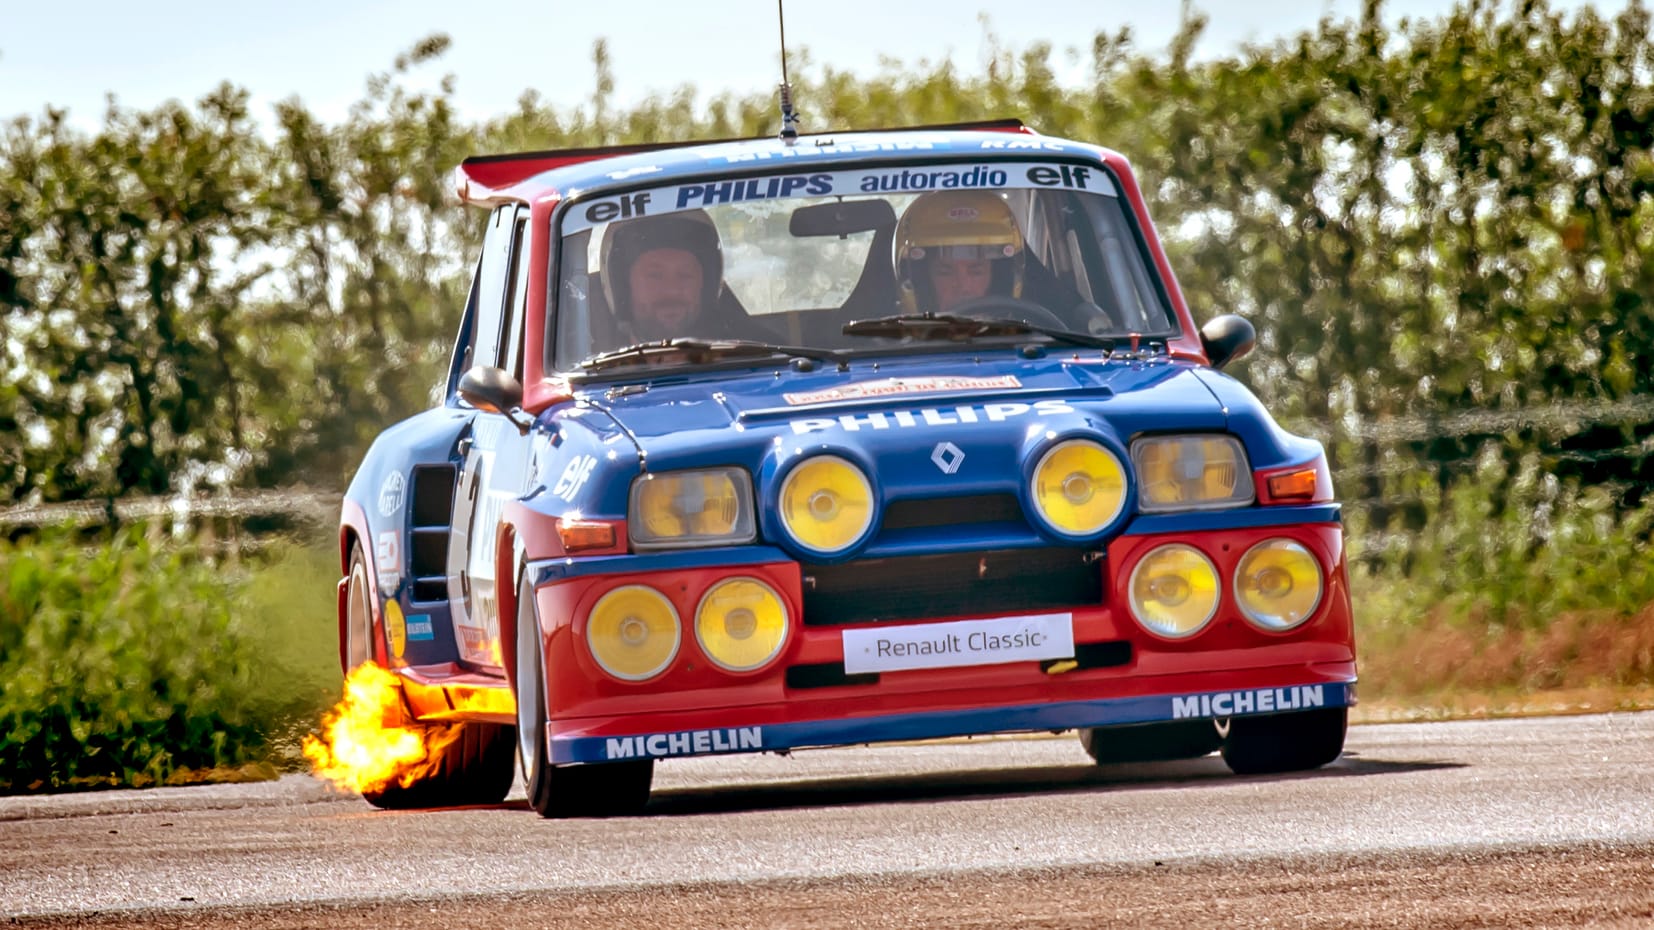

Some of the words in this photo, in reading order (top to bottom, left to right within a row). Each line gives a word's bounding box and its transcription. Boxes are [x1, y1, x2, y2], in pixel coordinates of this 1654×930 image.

[585, 193, 651, 223] elf
[676, 174, 833, 208] PHILIPS
[860, 166, 1007, 191] autoradio
[1027, 166, 1091, 188] elf
[789, 400, 1074, 434] PHILIPS
[553, 454, 598, 503] elf
[876, 633, 961, 658] Renault
[967, 628, 1041, 651] Classic
[1172, 685, 1324, 719] MICHELIN
[606, 726, 763, 759] MICHELIN
